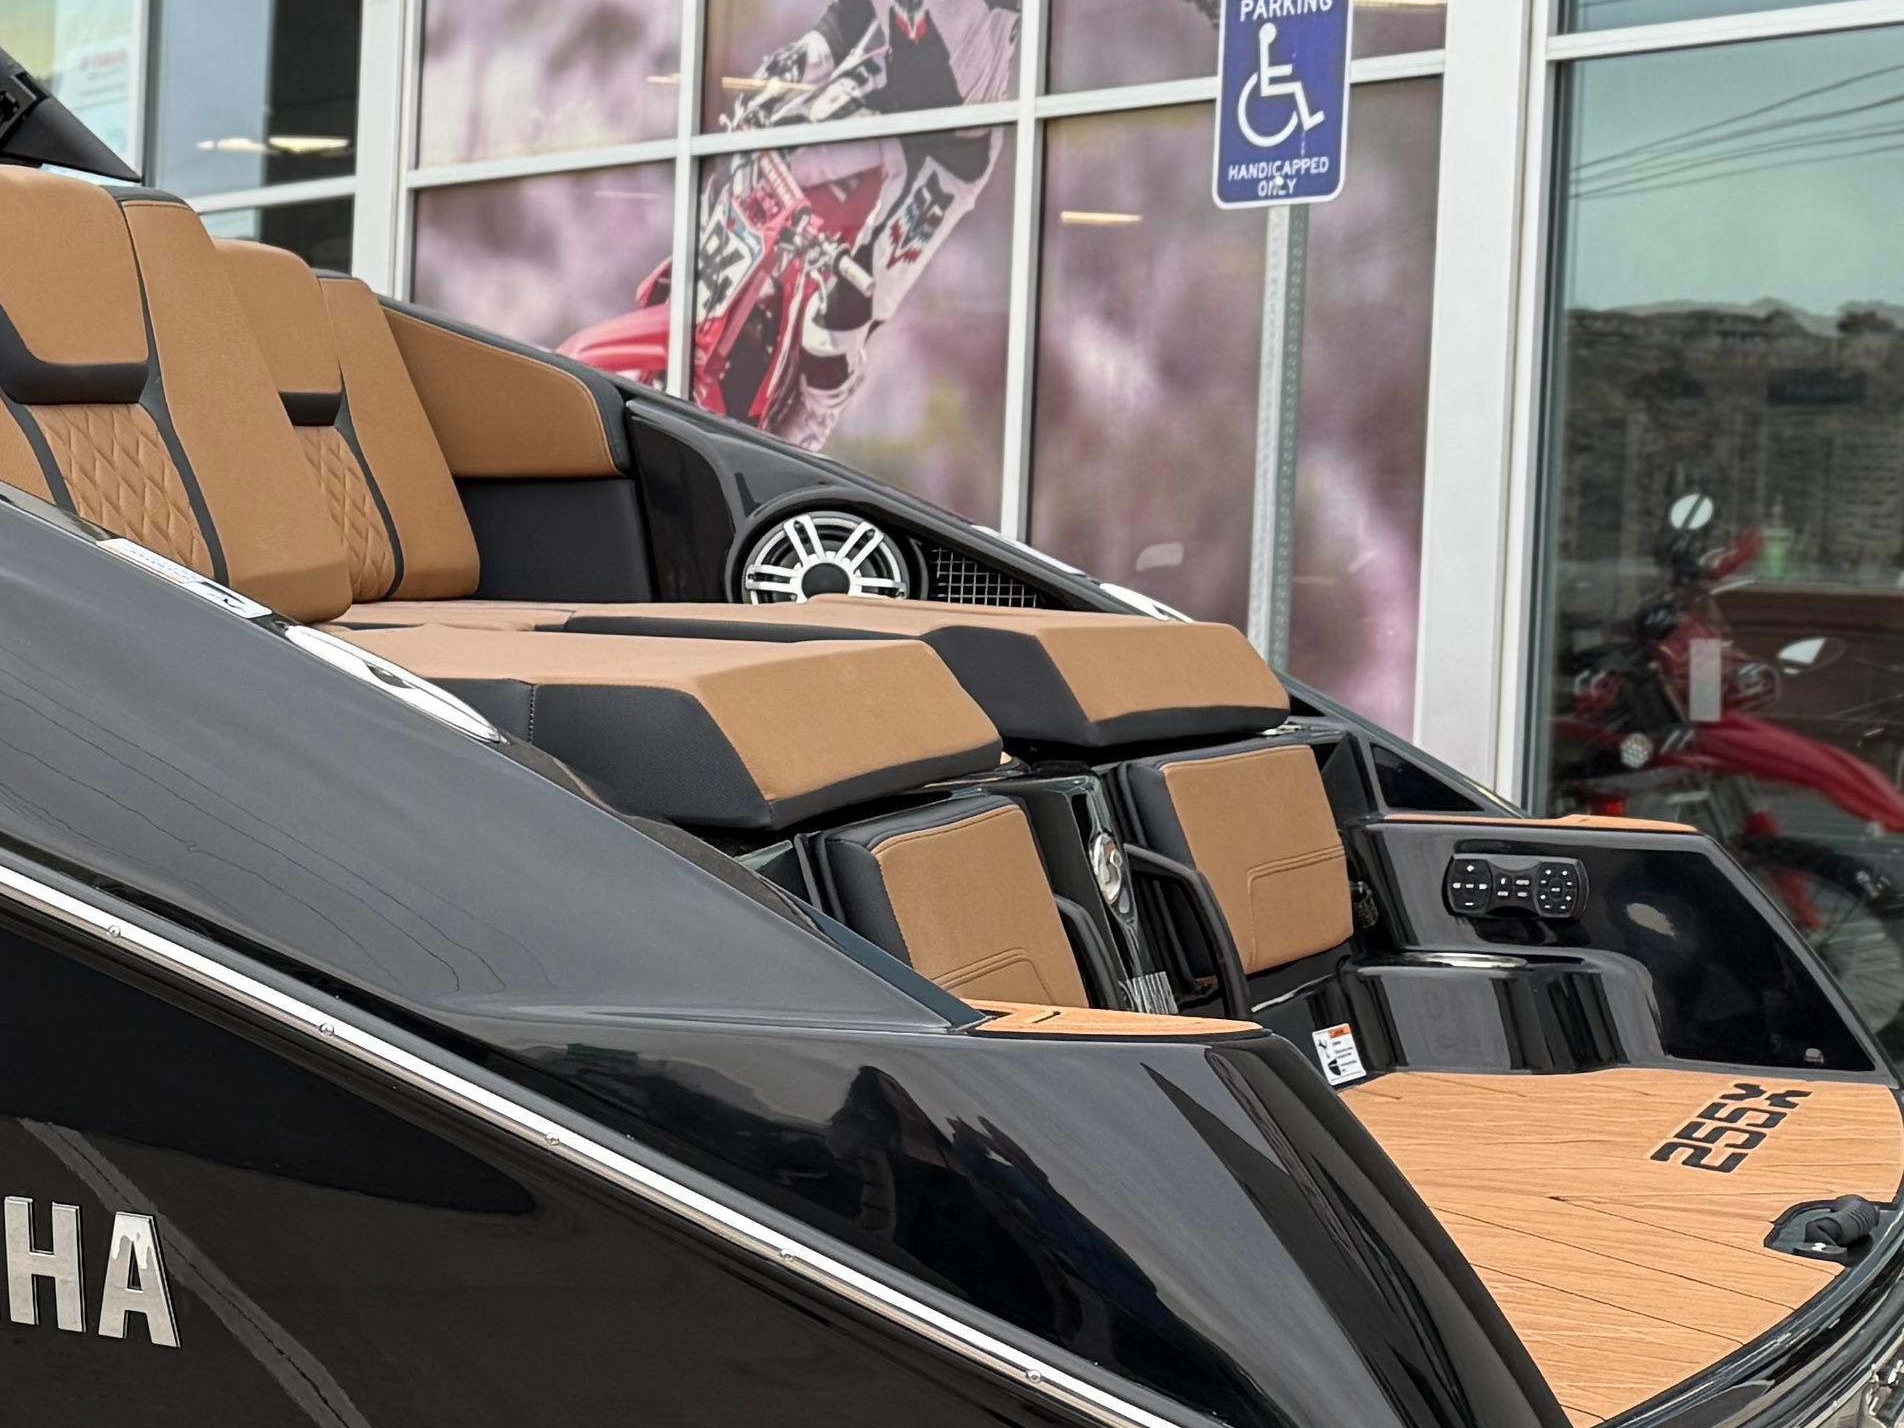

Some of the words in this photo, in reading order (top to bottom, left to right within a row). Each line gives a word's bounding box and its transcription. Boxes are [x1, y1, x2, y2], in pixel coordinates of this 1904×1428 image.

[1227, 156, 1330, 181] HANDICAPPED
[1257, 178, 1297, 197] ONLY
[1649, 1082, 1813, 1173] 255X
